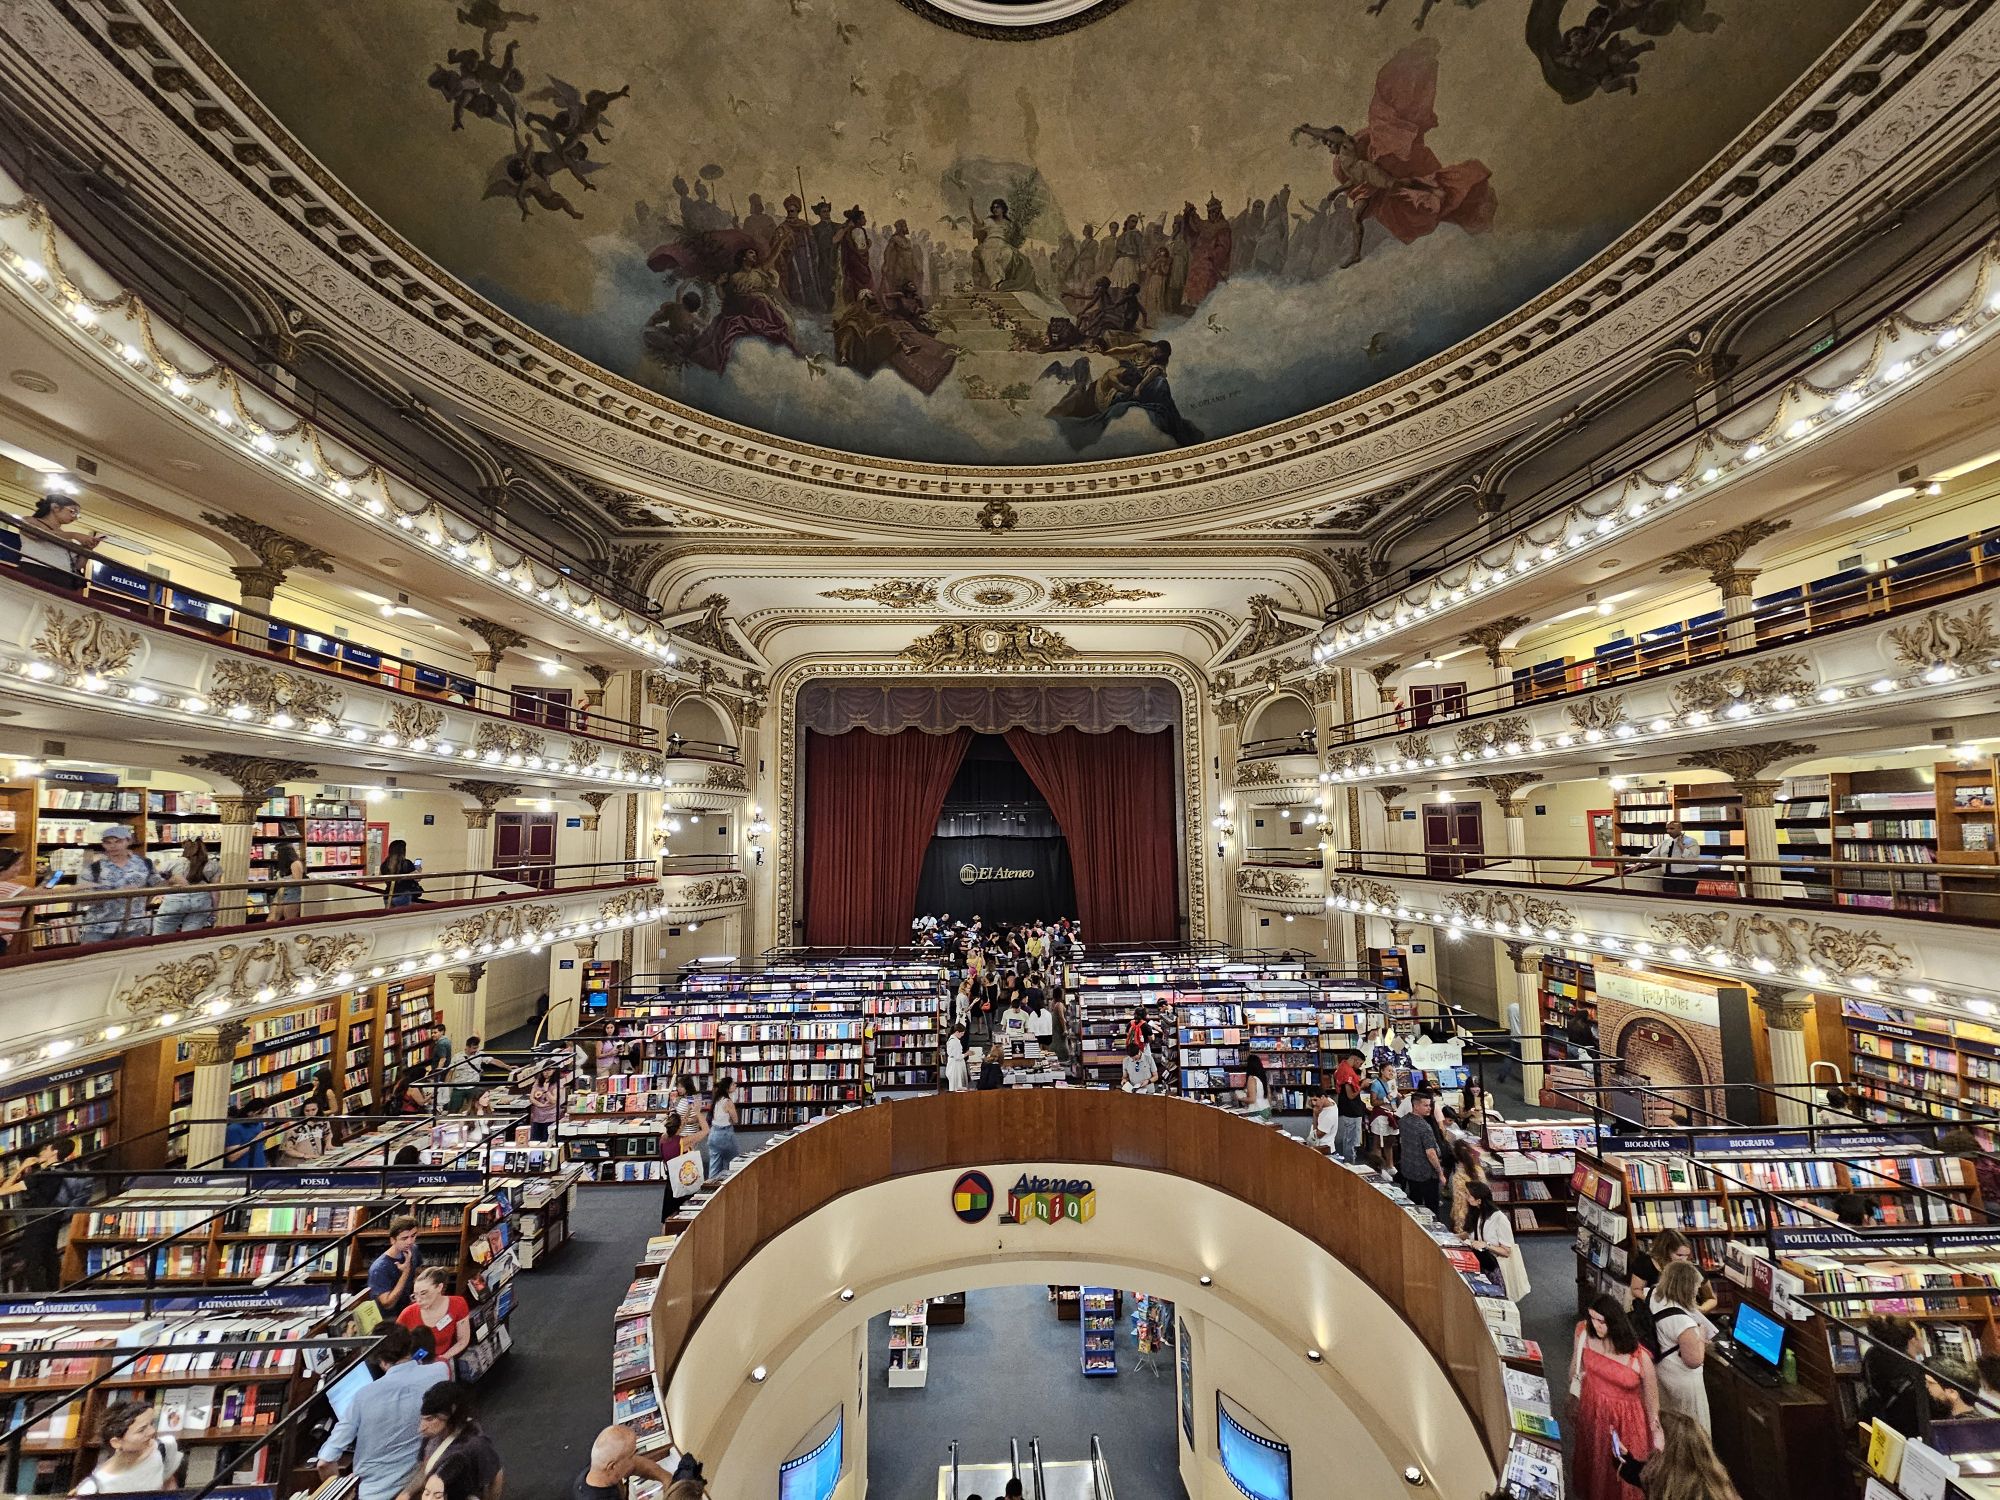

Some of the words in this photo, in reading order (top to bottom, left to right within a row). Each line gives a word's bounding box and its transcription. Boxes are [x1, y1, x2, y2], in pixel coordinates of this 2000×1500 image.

[55, 773, 83, 781] COCINA
[978, 867, 993, 879] El
[993, 866, 1034, 879] Ateneo
[1877, 1024, 1913, 1036] JUVENILES
[49, 1068, 84, 1083] NOVELAS
[1624, 1139, 1670, 1148] BIOGRAFÍAS
[1013, 1173, 1092, 1193] Ateneo
[1009, 1197, 1095, 1219] Junior
[9, 1303, 97, 1314] LATINOAMERICANA
[198, 1298, 283, 1309] LATINOAMERICANA
